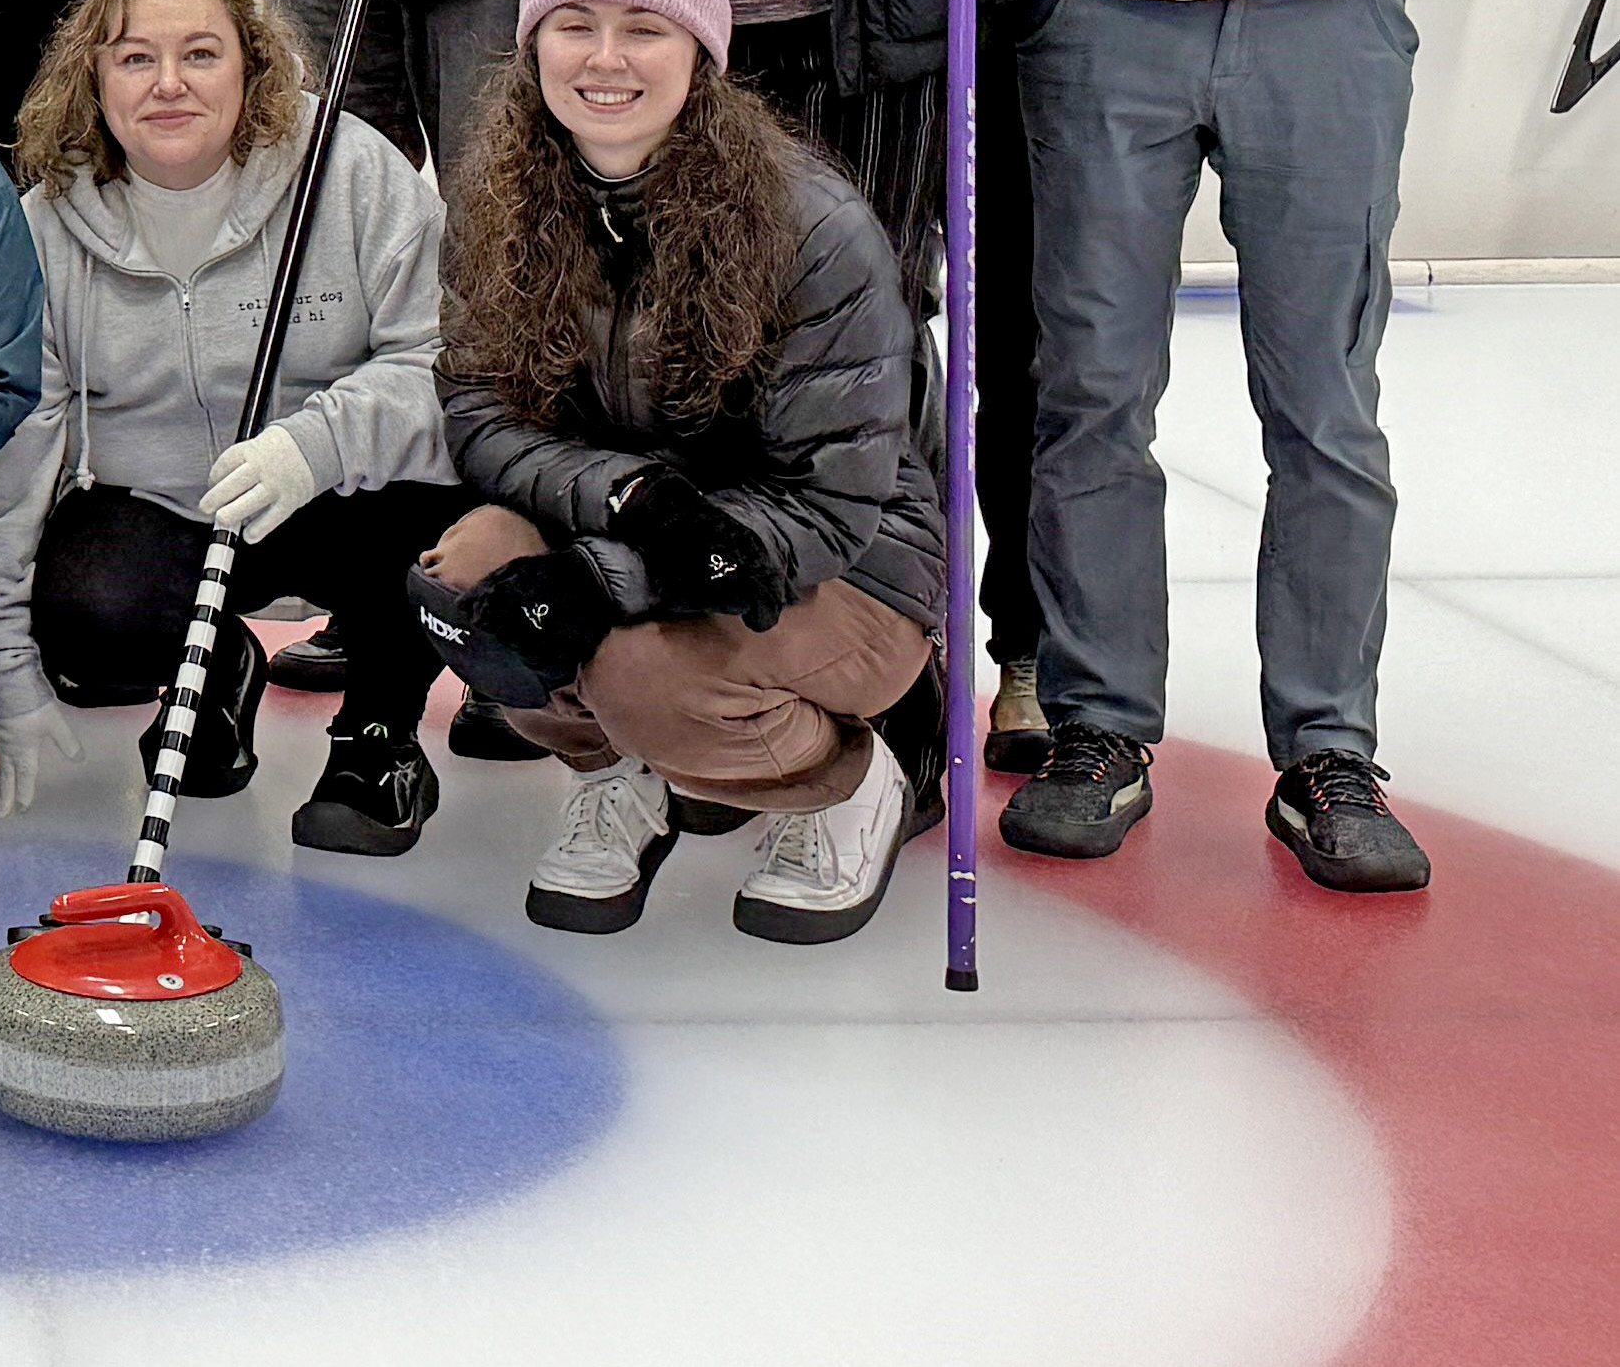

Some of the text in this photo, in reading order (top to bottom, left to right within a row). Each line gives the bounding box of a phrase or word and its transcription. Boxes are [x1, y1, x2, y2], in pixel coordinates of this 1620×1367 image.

[320, 291, 343, 303] dog
[309, 310, 325, 322] hi
[420, 605, 466, 646] HDX
